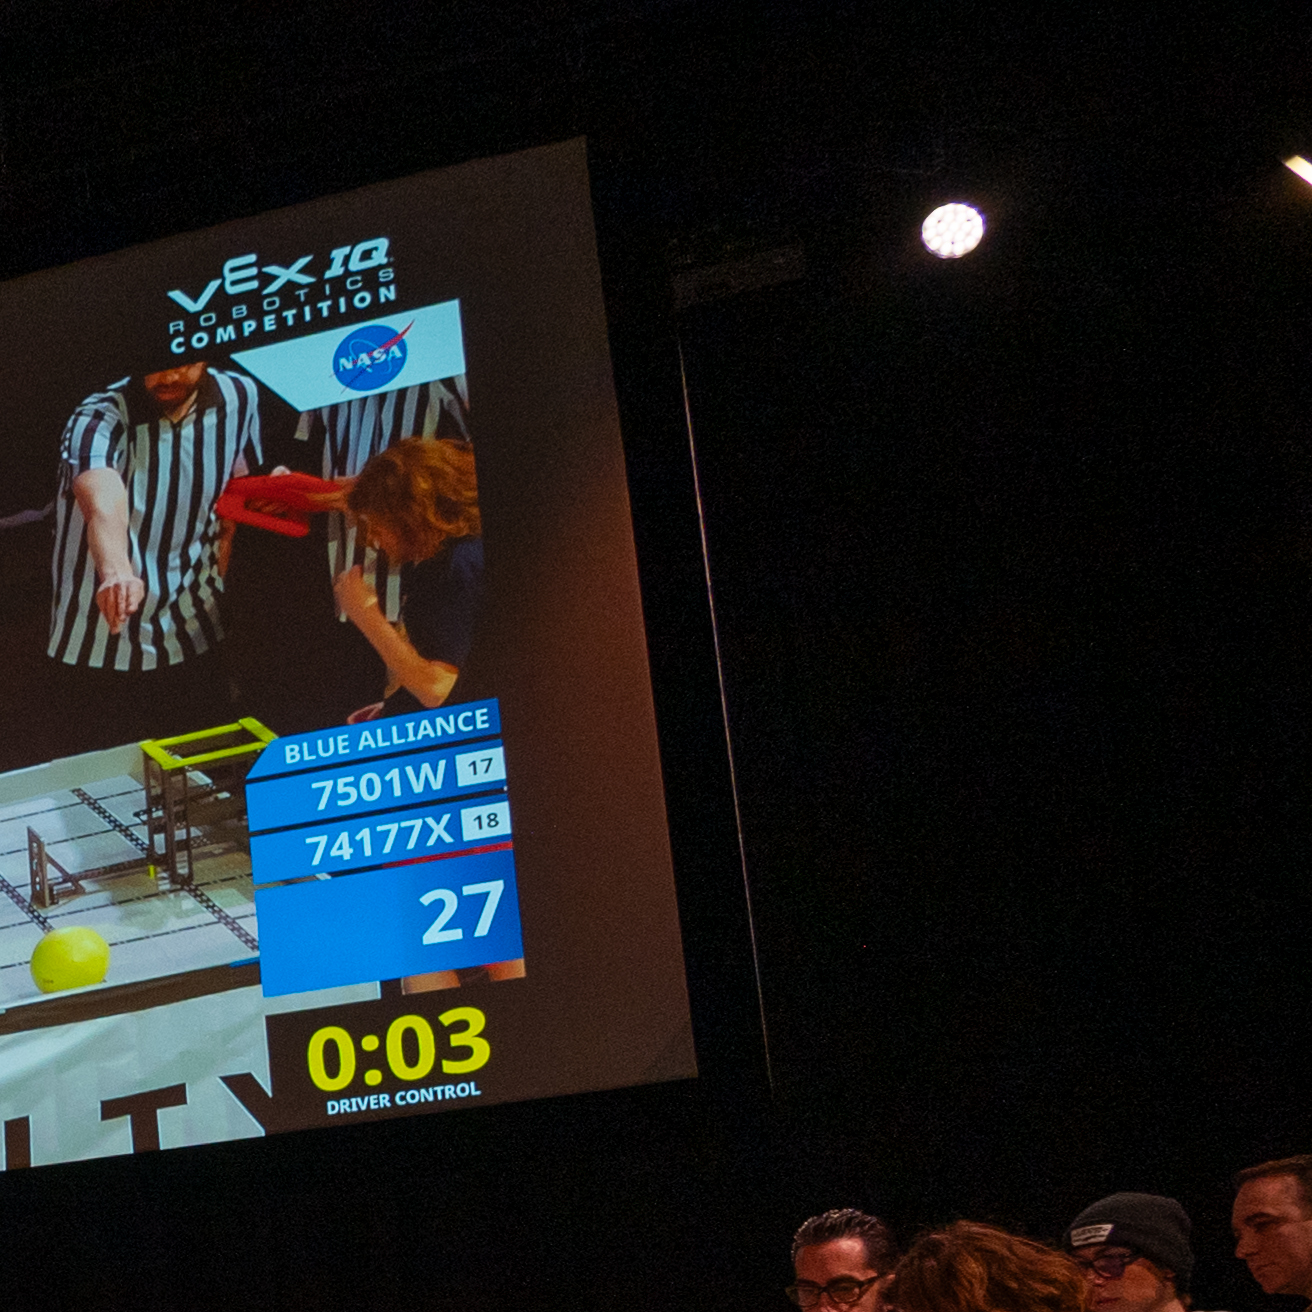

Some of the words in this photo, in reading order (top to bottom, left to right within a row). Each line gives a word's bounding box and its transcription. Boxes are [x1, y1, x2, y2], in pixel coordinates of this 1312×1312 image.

[167, 253, 315, 313] VEX
[324, 237, 390, 279] IQ
[169, 267, 395, 335] ROBOTICS
[170, 283, 397, 354] COMPETITION
[338, 343, 403, 374] NASA
[284, 735, 350, 764] BLUE
[358, 708, 490, 752] ALLIANCE
[311, 759, 447, 811] 7501W
[468, 757, 494, 777] 17
[305, 813, 454, 866] 74177X
[473, 811, 500, 831] 18
[419, 879, 505, 946] 27
[307, 1006, 491, 1092] 0:03
[327, 1092, 391, 1115] DRIVER
[395, 1081, 482, 1107] CONTROL
